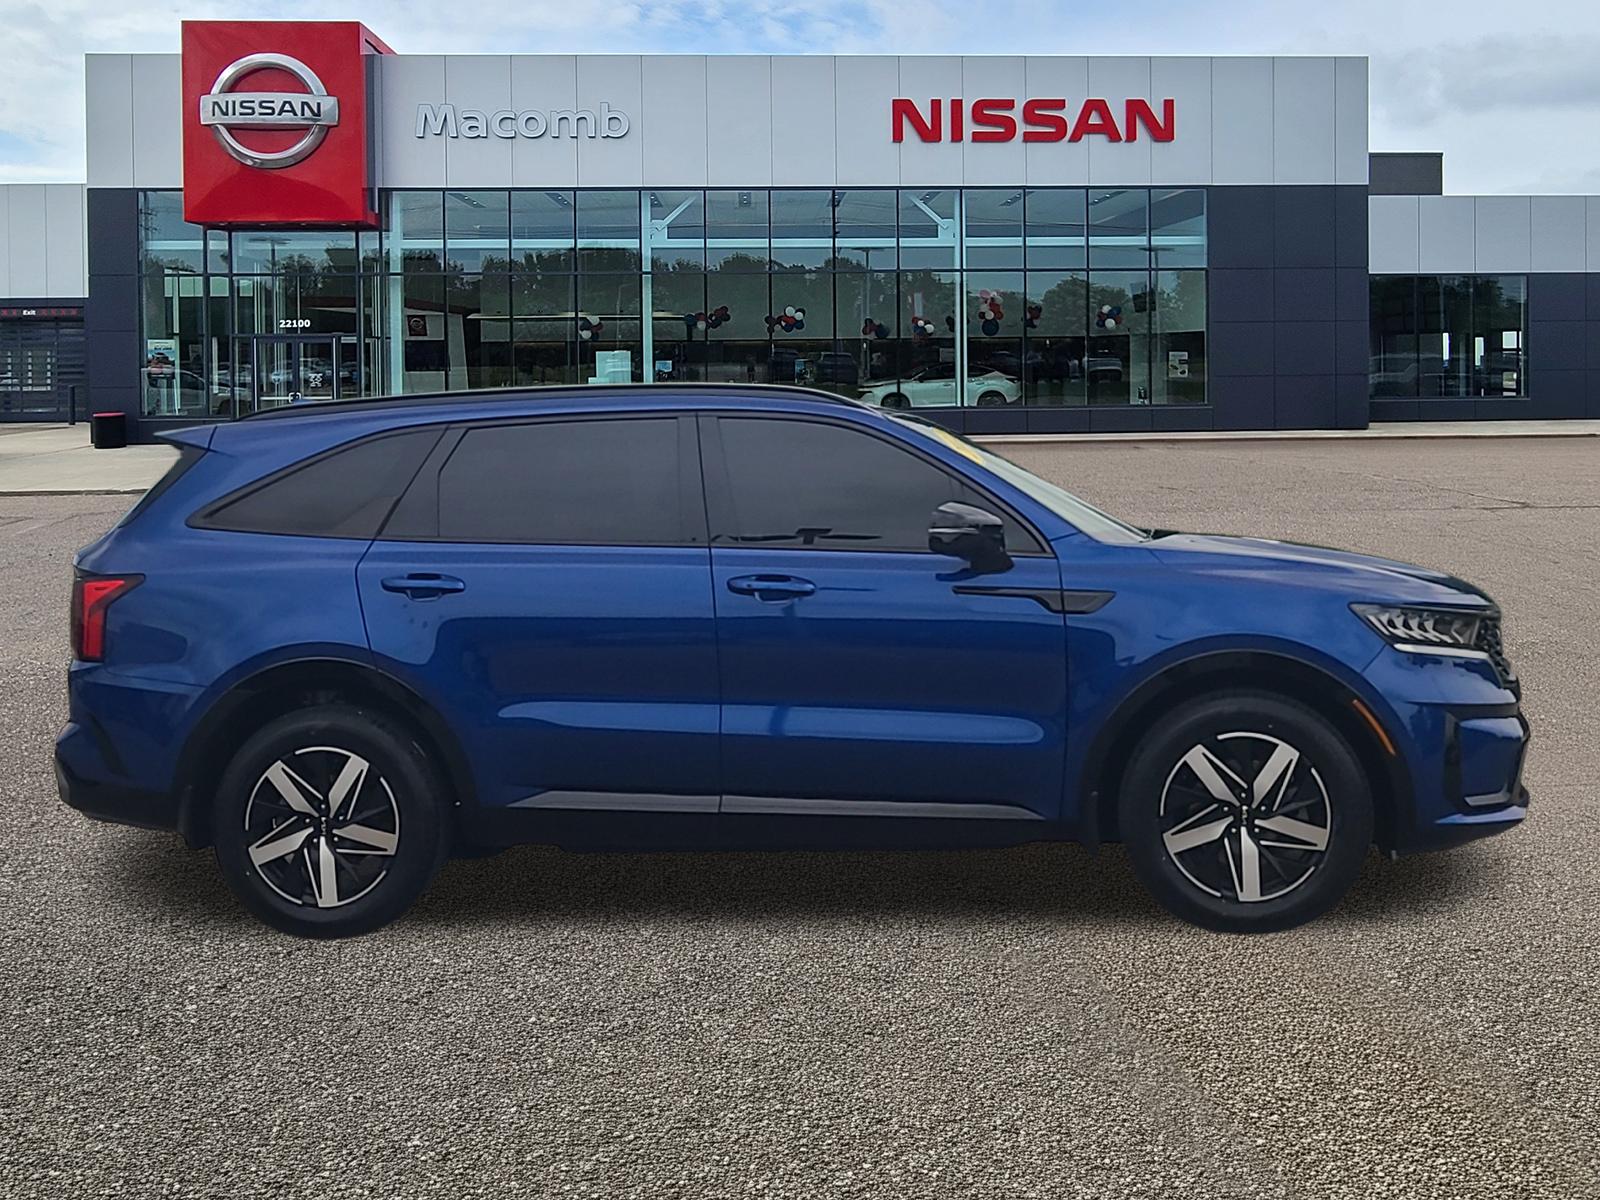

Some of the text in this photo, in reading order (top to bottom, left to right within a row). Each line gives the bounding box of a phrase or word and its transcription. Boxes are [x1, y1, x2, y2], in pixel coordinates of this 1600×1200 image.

[211, 100, 322, 117] NISSAN
[415, 102, 630, 139] Macomb
[892, 98, 1175, 143] NISSAN
[279, 319, 311, 328] 22100
